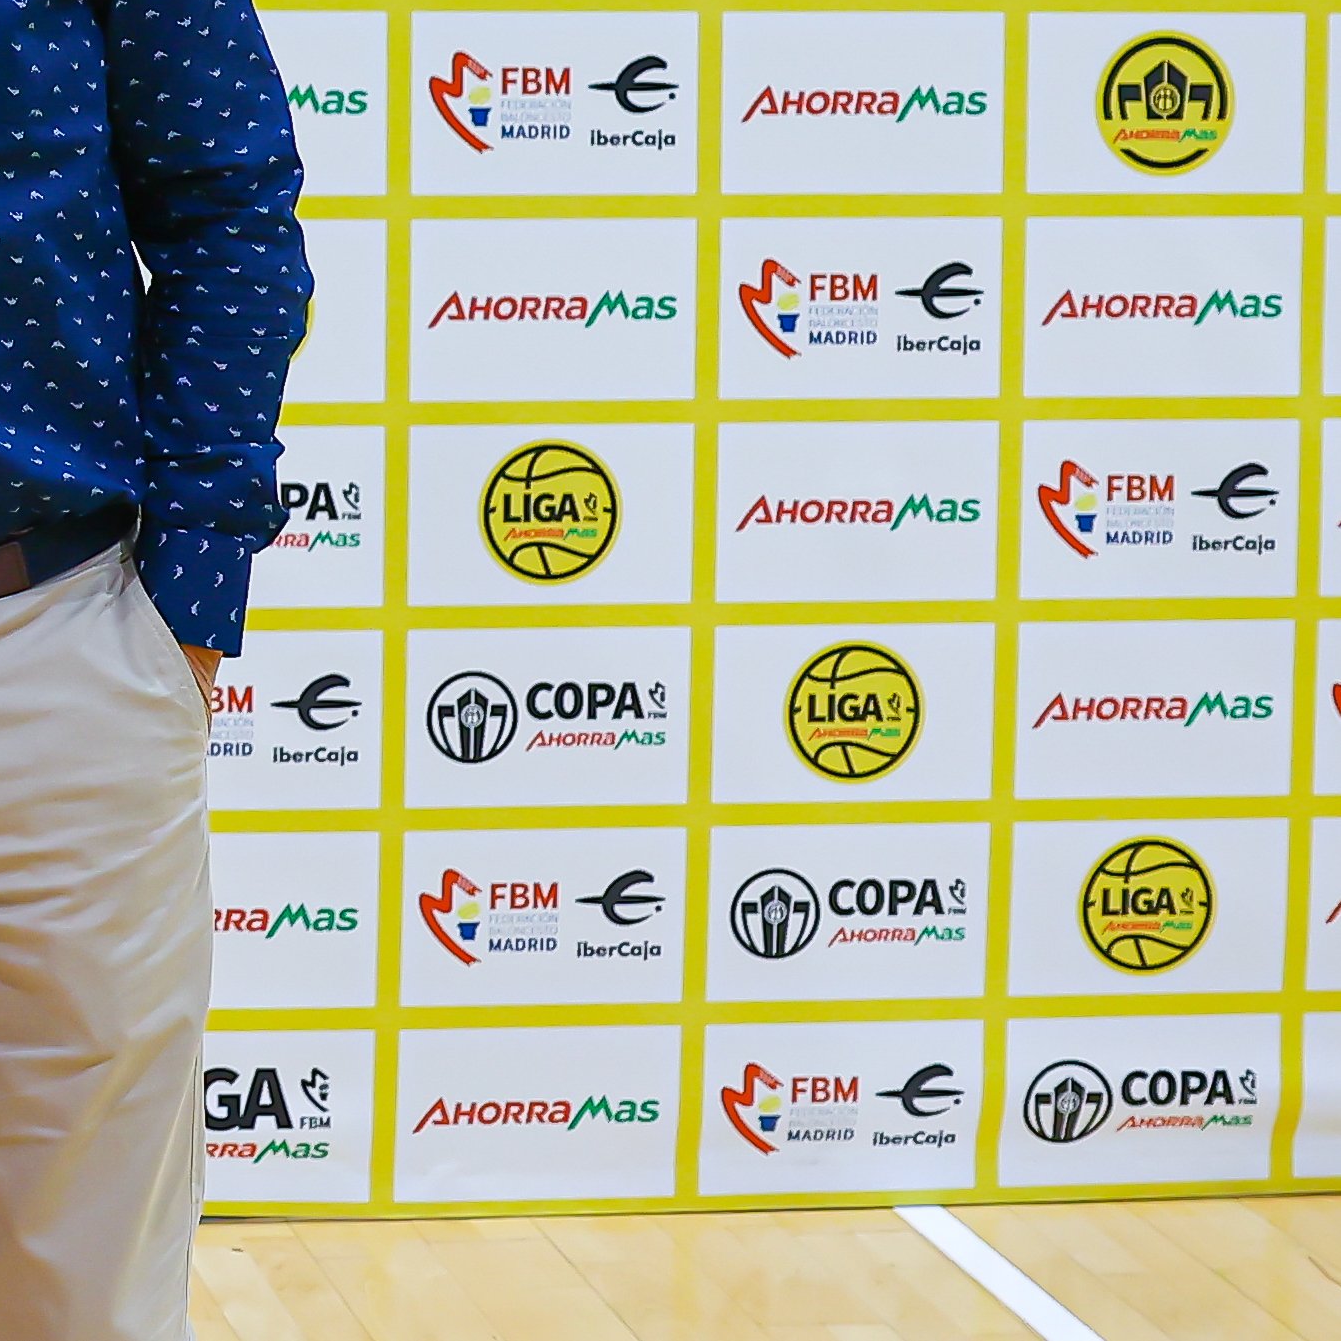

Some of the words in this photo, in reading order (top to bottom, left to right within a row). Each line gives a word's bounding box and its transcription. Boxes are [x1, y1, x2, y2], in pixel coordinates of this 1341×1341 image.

[501, 65, 571, 97] FBM
[500, 123, 571, 141] MADRID
[808, 272, 879, 303] FBM
[808, 329, 878, 346] MADRID
[1106, 473, 1175, 503] FBM
[501, 489, 582, 525] LIGA
[1105, 529, 1174, 546] MADRID
[525, 680, 650, 722] COPA
[808, 690, 884, 724] LIGA
[489, 881, 559, 911] FBM
[827, 877, 946, 918] COPA
[1101, 886, 1177, 918] LIGA
[488, 937, 558, 953] MADRID
[790, 1075, 859, 1105] FBM
[1120, 1068, 1237, 1108] COPA
[786, 1127, 855, 1142] MADRID
